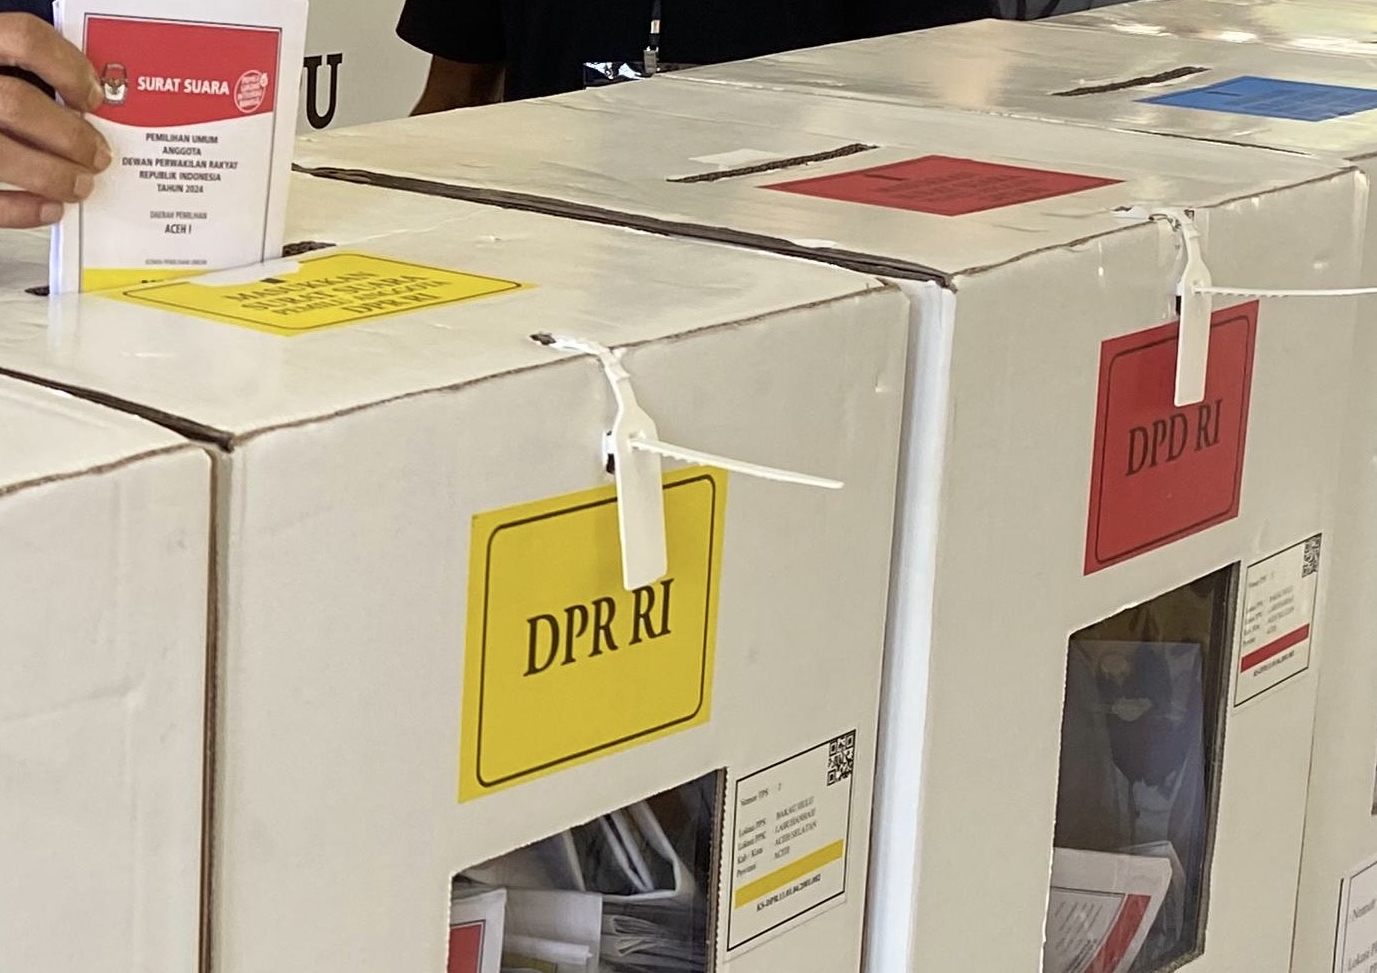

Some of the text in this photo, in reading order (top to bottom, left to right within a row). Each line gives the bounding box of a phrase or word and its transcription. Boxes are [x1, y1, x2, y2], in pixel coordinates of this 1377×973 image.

[137, 76, 181, 92] SURAT
[183, 79, 230, 95] SUARA
[145, 133, 219, 144] PEMILIHAN UMUM
[162, 146, 202, 156] ANGGOTA
[122, 157, 238, 169] DEWAN PERWAKILAN RAKYAT
[139, 170, 221, 181] REPUBLIK INDONESIA
[157, 183, 204, 193] TAHUN 2024
[165, 224, 186, 234] ACEH
[224, 271, 377, 302] MASUKKAN
[241, 275, 428, 311] SURAT SUARA
[342, 293, 440, 314] DPR RI
[1126, 398, 1222, 476] DPD RI
[523, 578, 674, 677] DPR RI
